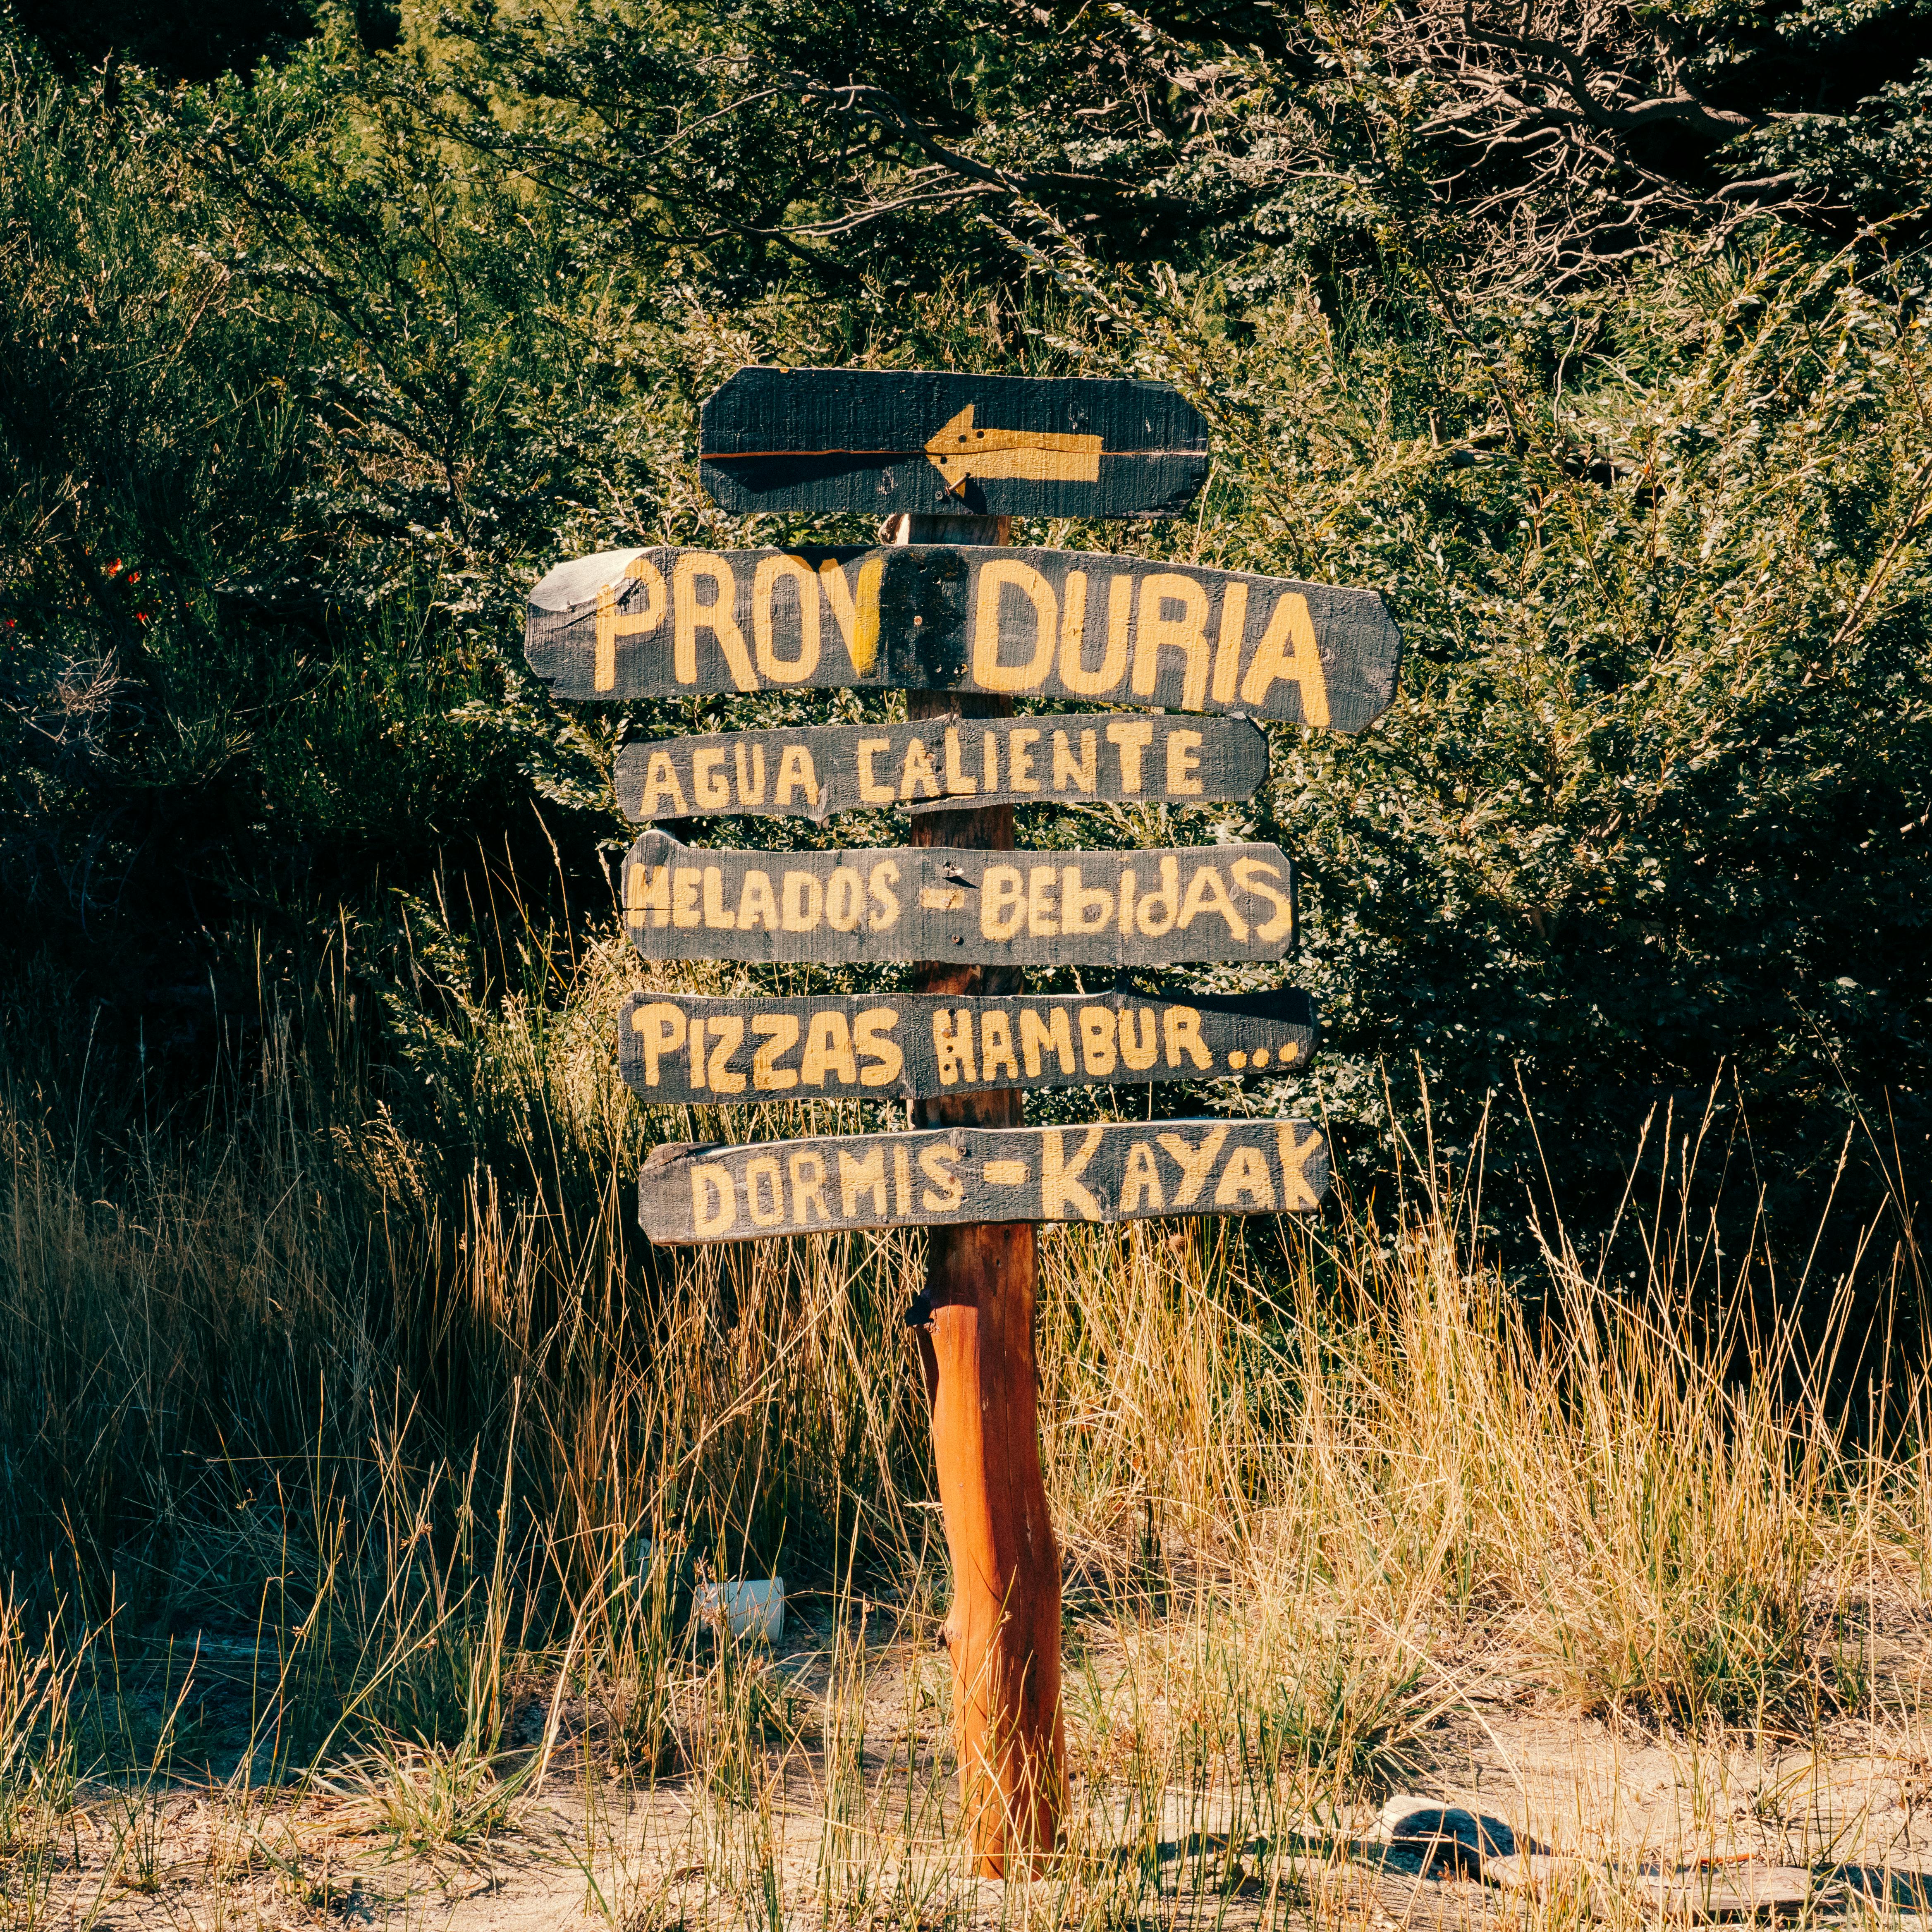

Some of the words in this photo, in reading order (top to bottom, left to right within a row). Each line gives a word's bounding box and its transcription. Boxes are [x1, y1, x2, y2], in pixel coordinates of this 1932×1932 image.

[641, 743, 820, 815] AGUA
[857, 721, 1203, 803] CALIENTE
[626, 858, 901, 930] HELADOS
[631, 1003, 904, 1093] PIZZAS
[690, 1145, 964, 1236] DORMIS
[1042, 1121, 1322, 1221] KAYAK
